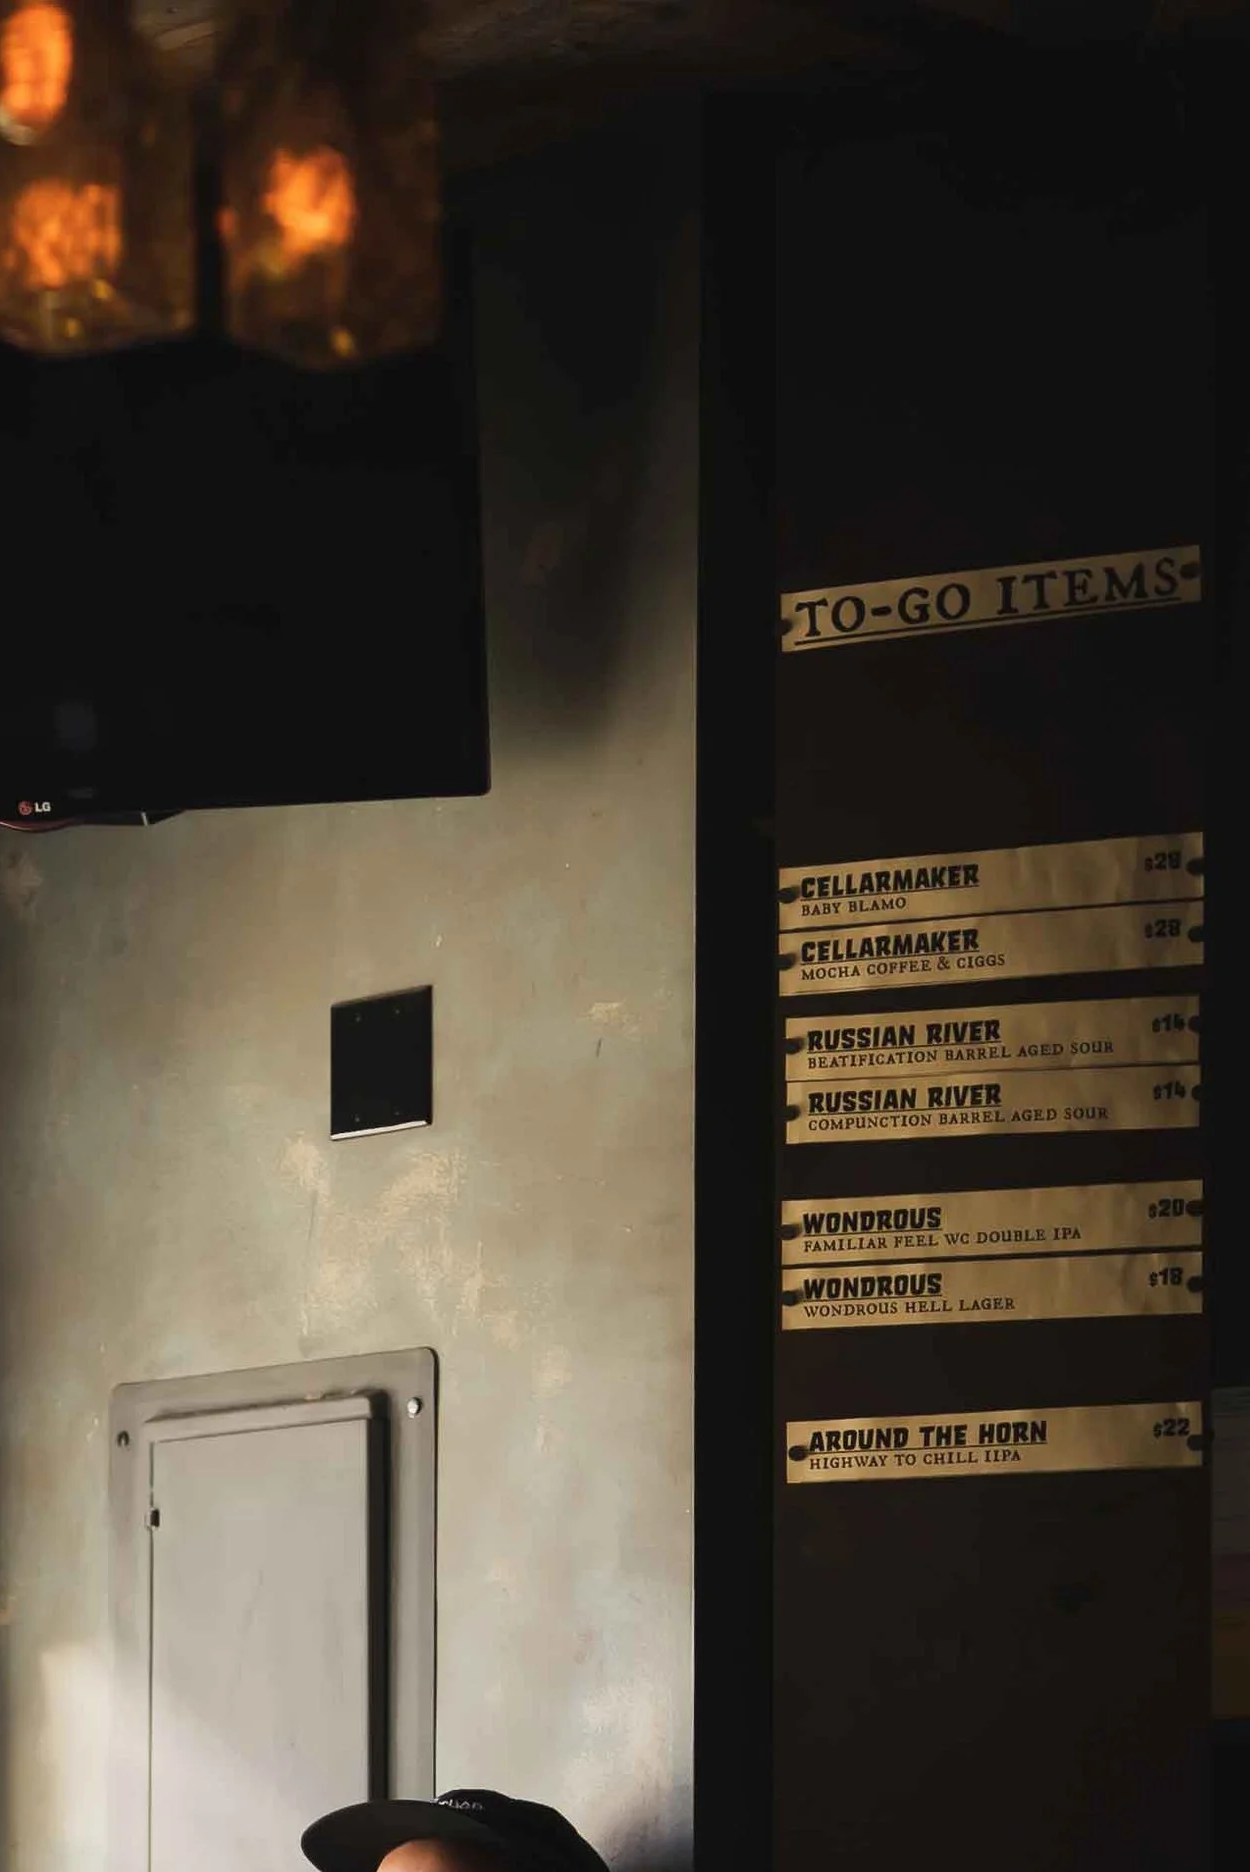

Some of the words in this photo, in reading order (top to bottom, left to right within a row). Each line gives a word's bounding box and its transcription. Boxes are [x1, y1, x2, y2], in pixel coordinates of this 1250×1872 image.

[794, 582, 971, 638] TO-GO
[996, 556, 1180, 616] ITEMS
[34, 801, 52, 813] LG
[800, 863, 980, 900] CELLARMAKER
[801, 902, 842, 917] BABY
[849, 897, 907, 913] BLAMO
[800, 928, 980, 963] CELLARMAKER
[801, 965, 861, 981] MOCHA
[867, 959, 932, 975] COFFEE
[937, 955, 952, 970] &
[956, 953, 1006, 969] CIGGS
[807, 1024, 916, 1052] RUSSIAN
[926, 1019, 1001, 1045] RIVER
[808, 1050, 937, 1070] BEATIFICATION
[946, 1046, 1012, 1061] BARREL
[1018, 1043, 1064, 1057] AGED
[1070, 1041, 1115, 1055] SOUR
[808, 1087, 917, 1115] RUSSIAN
[927, 1083, 1002, 1109] RIVER
[808, 1114, 932, 1132] COMPUNCTION
[938, 1110, 1005, 1125] BARREL
[1011, 1108, 1056, 1122] AGED
[1062, 1106, 1110, 1121] SOUR
[803, 1206, 942, 1236] WONDROUS
[804, 1235, 888, 1253] FAMILIAR
[893, 1233, 939, 1248] FEEL
[944, 1232, 970, 1245] WC
[976, 1229, 1046, 1244] DOUBLE
[1053, 1227, 1082, 1241] IPA
[803, 1273, 943, 1300] WONDROUS
[804, 1301, 898, 1318] WONDROUS
[905, 1299, 952, 1313] HELL
[959, 1297, 1016, 1312] LAGER
[809, 1427, 909, 1452] AROUND
[919, 1424, 968, 1447] THE
[978, 1420, 1048, 1444] HORN
[1153, 1418, 1190, 1438] $22
[809, 1455, 888, 1470] HIGHWAY
[894, 1453, 917, 1466] TO
[923, 1450, 979, 1465] CHILL
[984, 1448, 1022, 1462] IIPA
